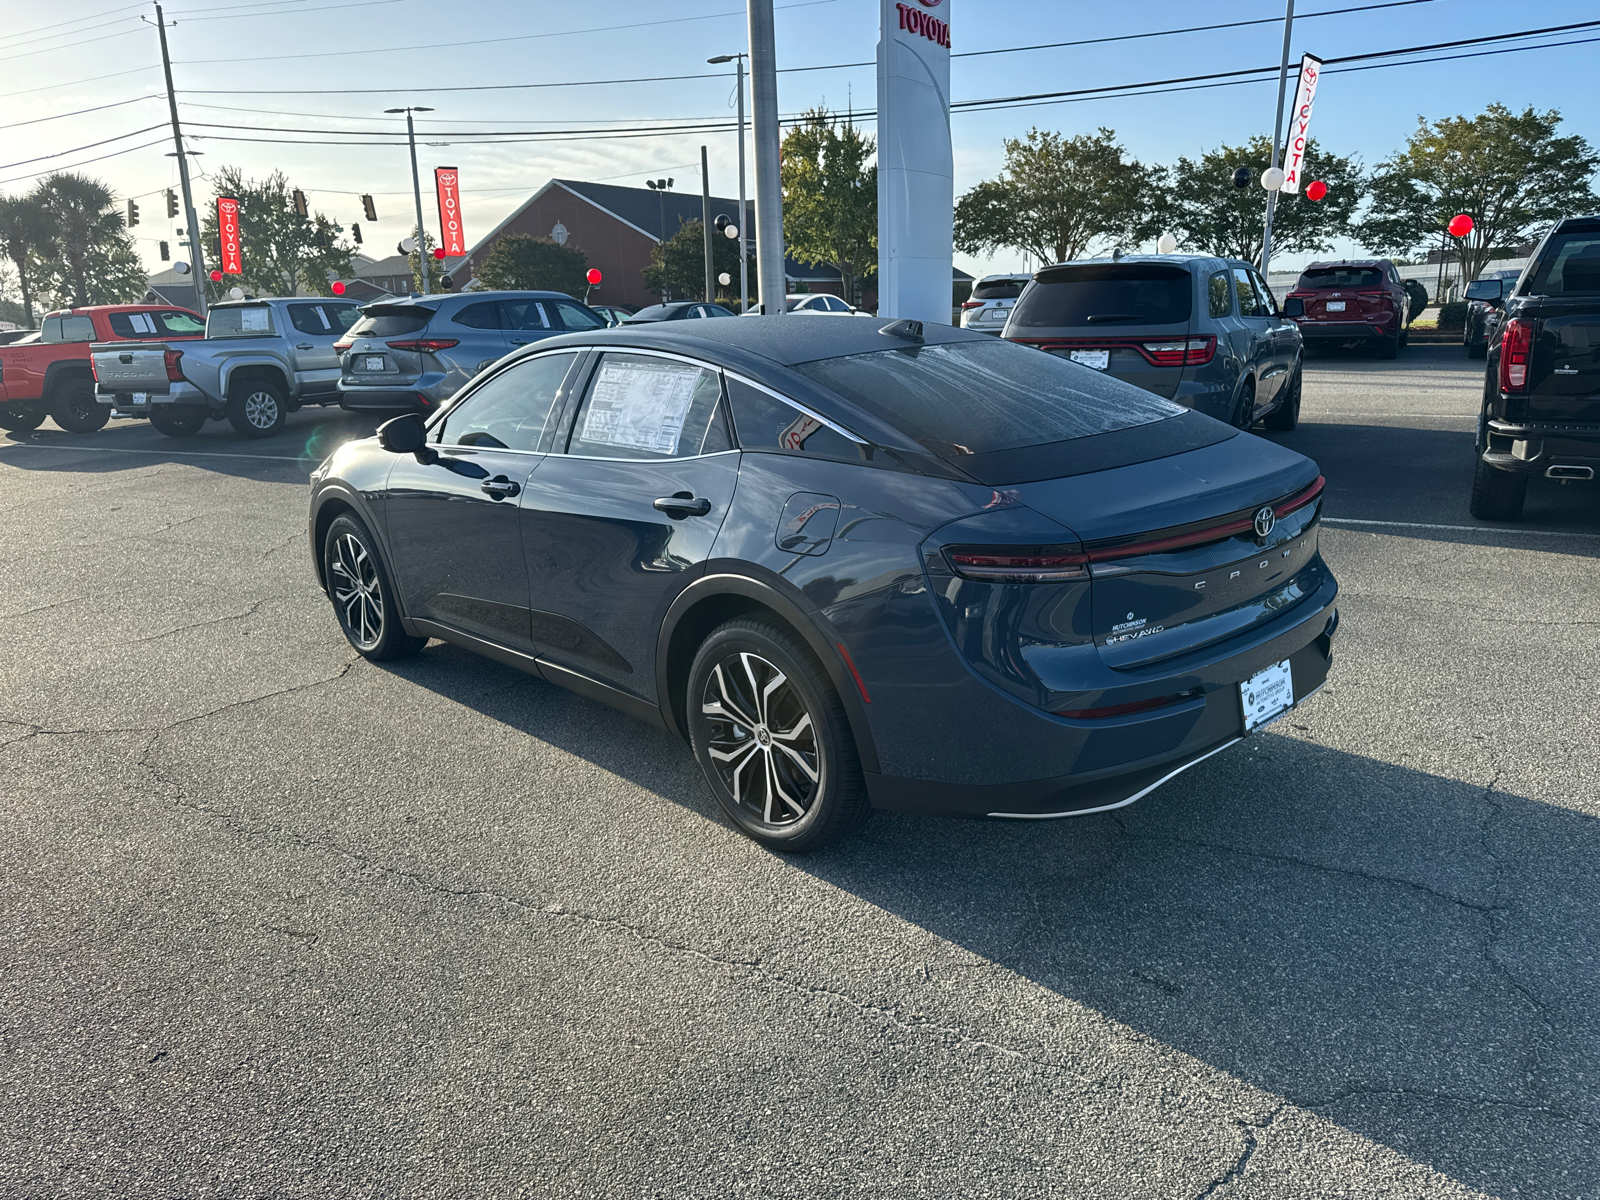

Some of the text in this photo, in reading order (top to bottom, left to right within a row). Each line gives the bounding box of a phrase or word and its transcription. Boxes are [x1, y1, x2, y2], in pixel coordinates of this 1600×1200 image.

[896, 3, 951, 48] TOYOTA
[1286, 88, 1312, 184] TOYOTA
[225, 214, 238, 271] TOYOTA
[445, 188, 460, 252] TOYOTA
[1194, 540, 1307, 590] CROWN
[1112, 618, 1147, 630] HUTCHINSON
[1137, 625, 1164, 639] AWD
[1255, 677, 1286, 700] HUTCHINSON
[1256, 686, 1285, 706] AUTOMOTIVE GROUP
